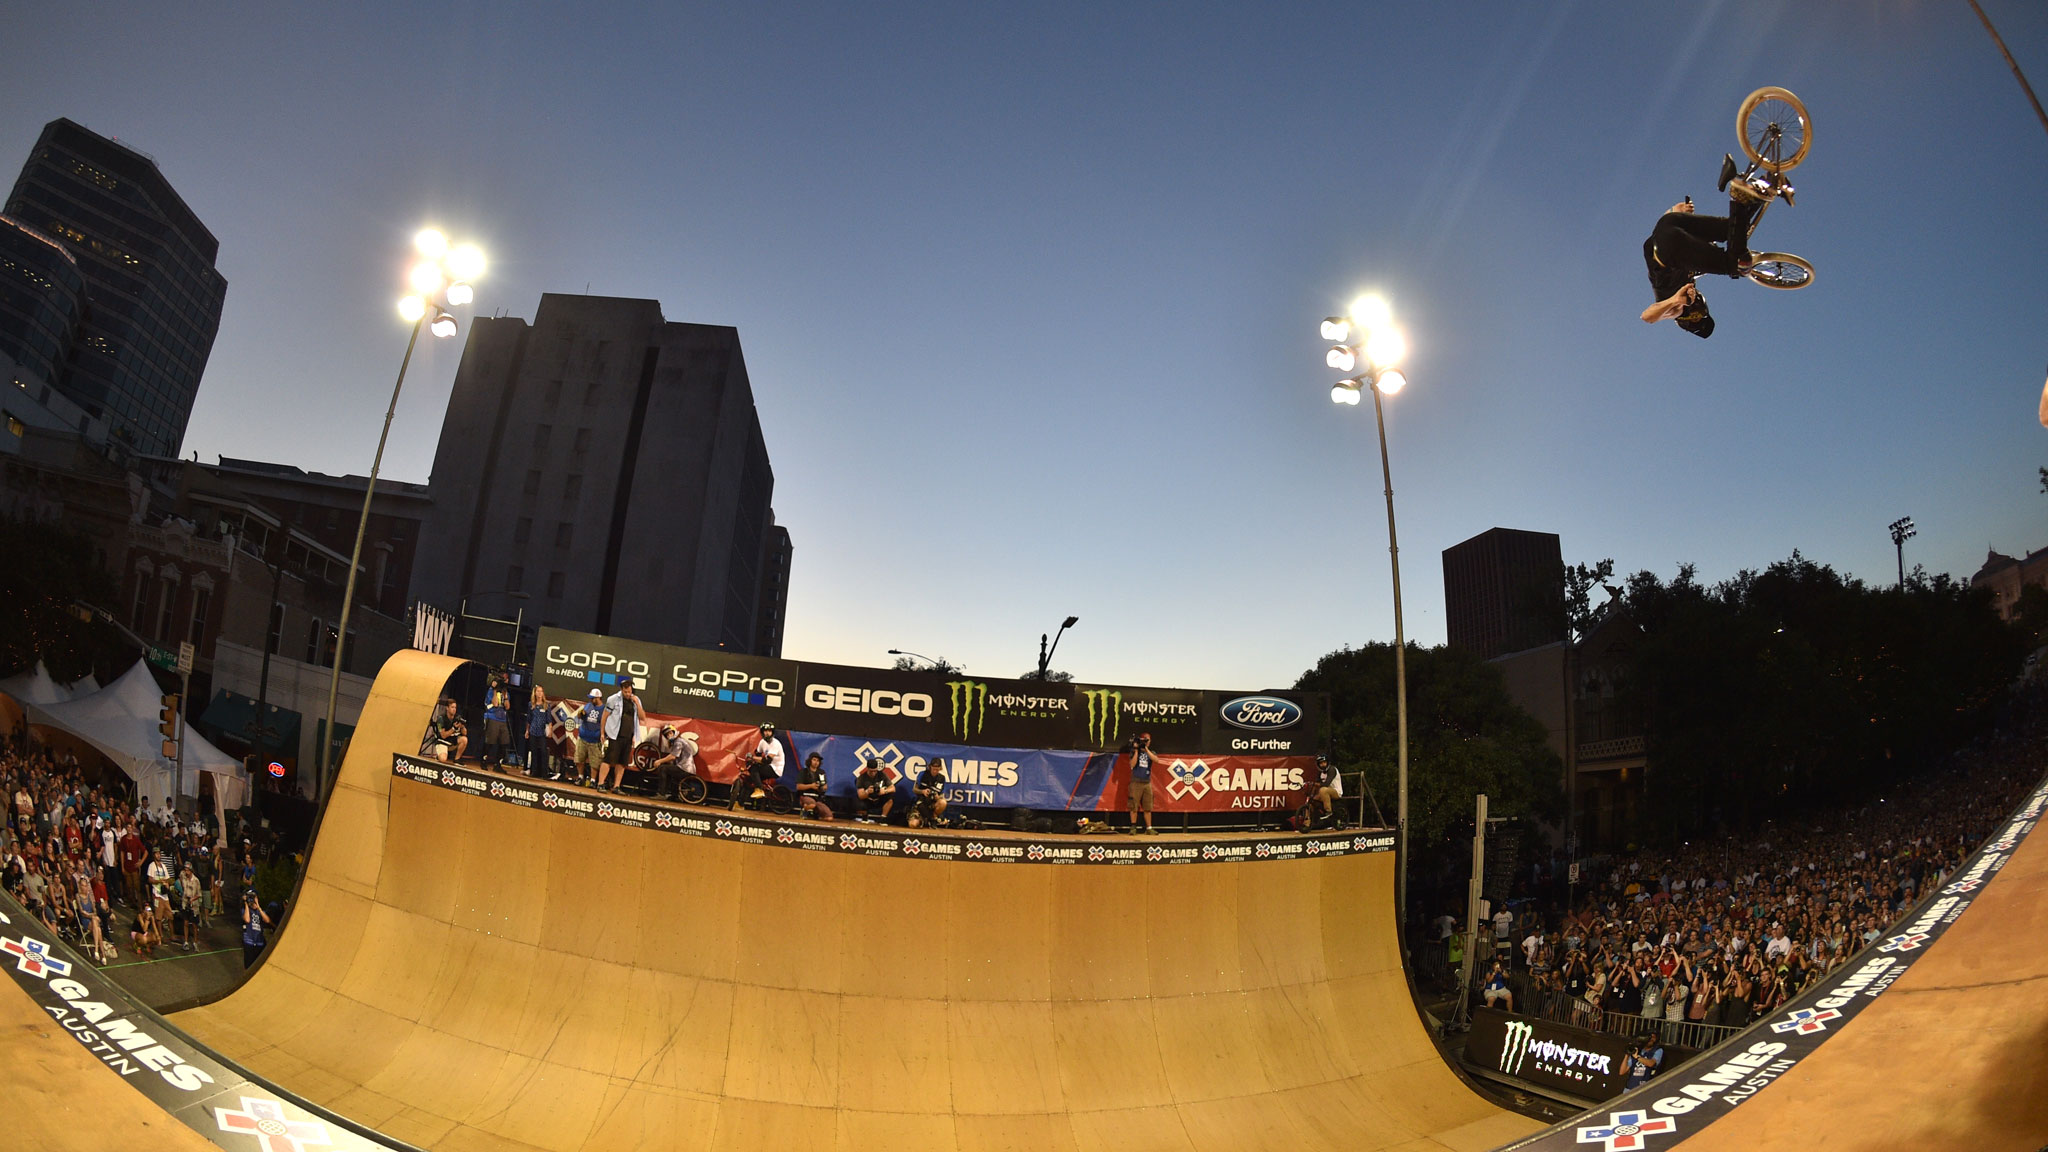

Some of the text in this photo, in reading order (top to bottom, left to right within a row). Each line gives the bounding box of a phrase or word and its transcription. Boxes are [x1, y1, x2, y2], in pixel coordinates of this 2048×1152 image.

[413, 609, 455, 656] NAVY
[546, 645, 649, 676] GoPro
[546, 666, 555, 675] Be
[560, 668, 585, 679] HERO.
[672, 664, 784, 693] GoPro
[673, 685, 683, 694] Be
[688, 687, 716, 698] HERO.
[804, 683, 933, 718] GEICO
[988, 692, 1070, 711] MONSTER
[1000, 709, 1057, 719] ENERGY
[1123, 700, 1198, 717] MONSTER
[1237, 700, 1287, 725] Ford
[1134, 716, 1187, 724] ENERGY
[1231, 738, 1292, 750] Go Further
[268, 763, 286, 776] OPEN
[408, 764, 438, 780] GAMES
[414, 775, 432, 784] AUSTIN
[455, 776, 487, 791] GAMES
[1211, 767, 1305, 792] GAMES
[461, 786, 480, 796] AUSTIN
[505, 788, 538, 802] GAMES
[942, 789, 994, 804] USTIN
[511, 798, 531, 807] AUSTIN
[558, 798, 594, 812] GAMES
[1231, 795, 1286, 809] AUSTIN
[565, 809, 586, 818] AUSTIN
[613, 808, 650, 822] GAMES
[620, 819, 642, 827] AUSTIN
[672, 817, 710, 831] GAMES
[680, 828, 702, 836] AUSTIN
[732, 826, 772, 838] GAMES
[794, 832, 835, 845] GAMES
[740, 836, 764, 844] AUSTIN
[857, 838, 898, 850] GAMES
[1320, 841, 1350, 851] GAMES
[1366, 837, 1395, 847] GAMES
[803, 843, 826, 851] AUSTIN
[920, 843, 961, 854] GAMES
[984, 846, 1023, 857] GAMES
[1044, 849, 1083, 858] GAMES
[1162, 848, 1198, 858] GAMES
[1217, 847, 1252, 856] GAMES
[1270, 844, 1302, 854] GAMES
[1105, 850, 1142, 859] GAMES
[1905, 896, 1961, 934] GAMES
[1815, 956, 1897, 1009] GAMES
[1864, 965, 1909, 997] AUSTIN
[45, 1005, 140, 1076] AUSTIN
[48, 978, 215, 1091] GAMES
[1527, 1038, 1612, 1075] MONSTER
[1535, 1061, 1594, 1083] ENERGY
[1651, 1040, 1788, 1115] GAMES
[1722, 1058, 1797, 1106] AUSTIN
